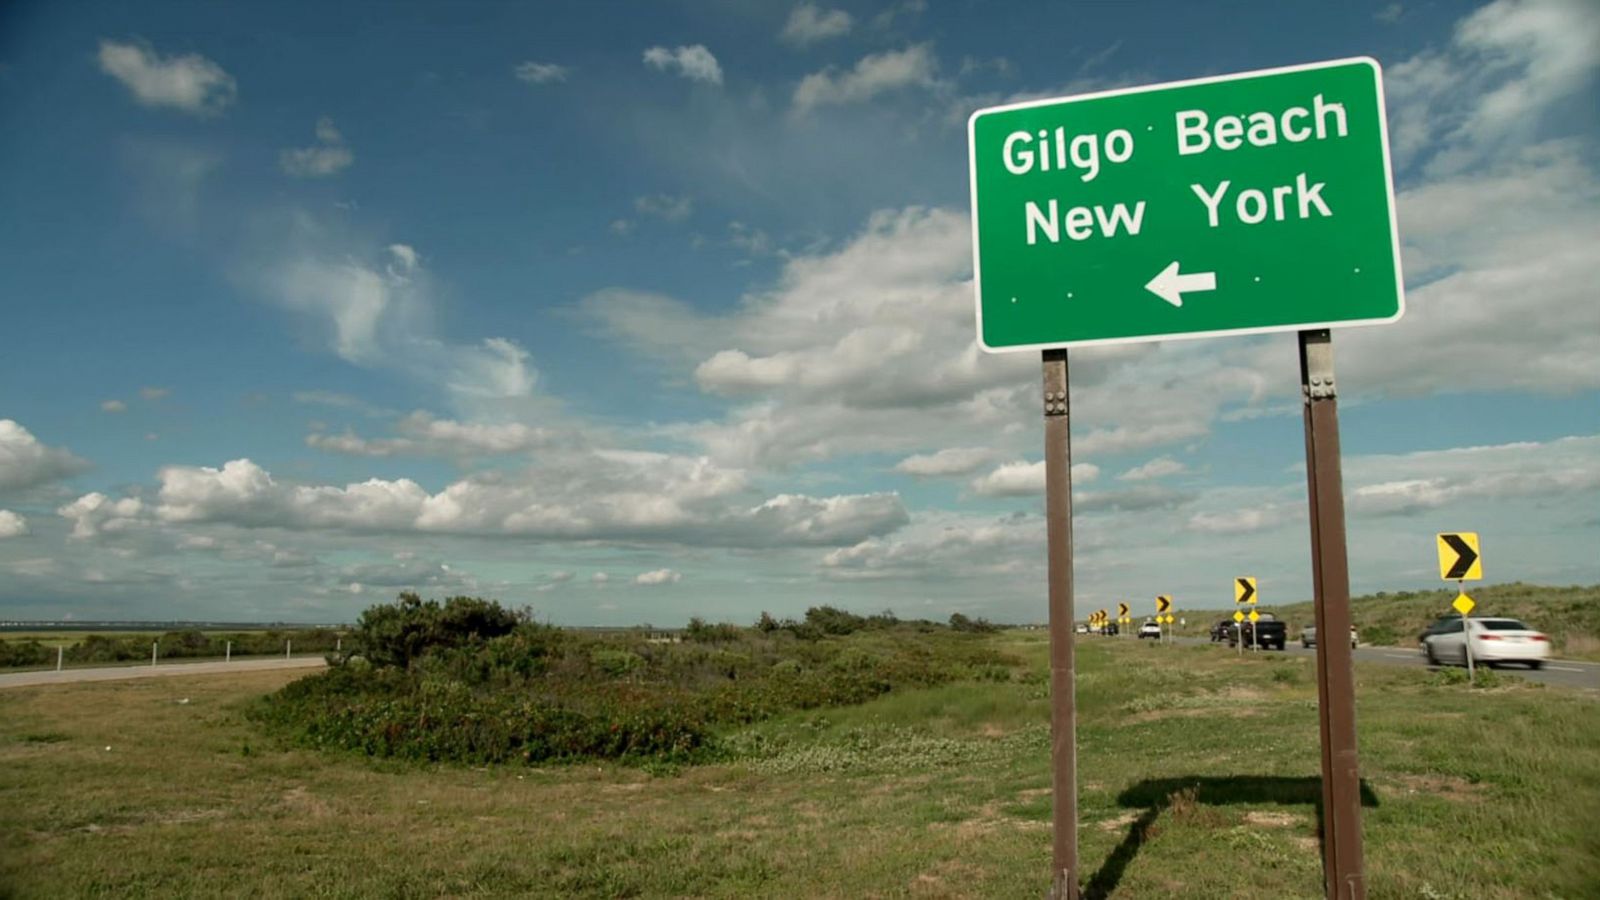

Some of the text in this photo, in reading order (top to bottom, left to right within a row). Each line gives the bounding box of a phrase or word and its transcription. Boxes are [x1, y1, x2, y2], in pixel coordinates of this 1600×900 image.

[1003, 94, 1349, 182] Gilgo Beach
[1025, 173, 1333, 245] New York
